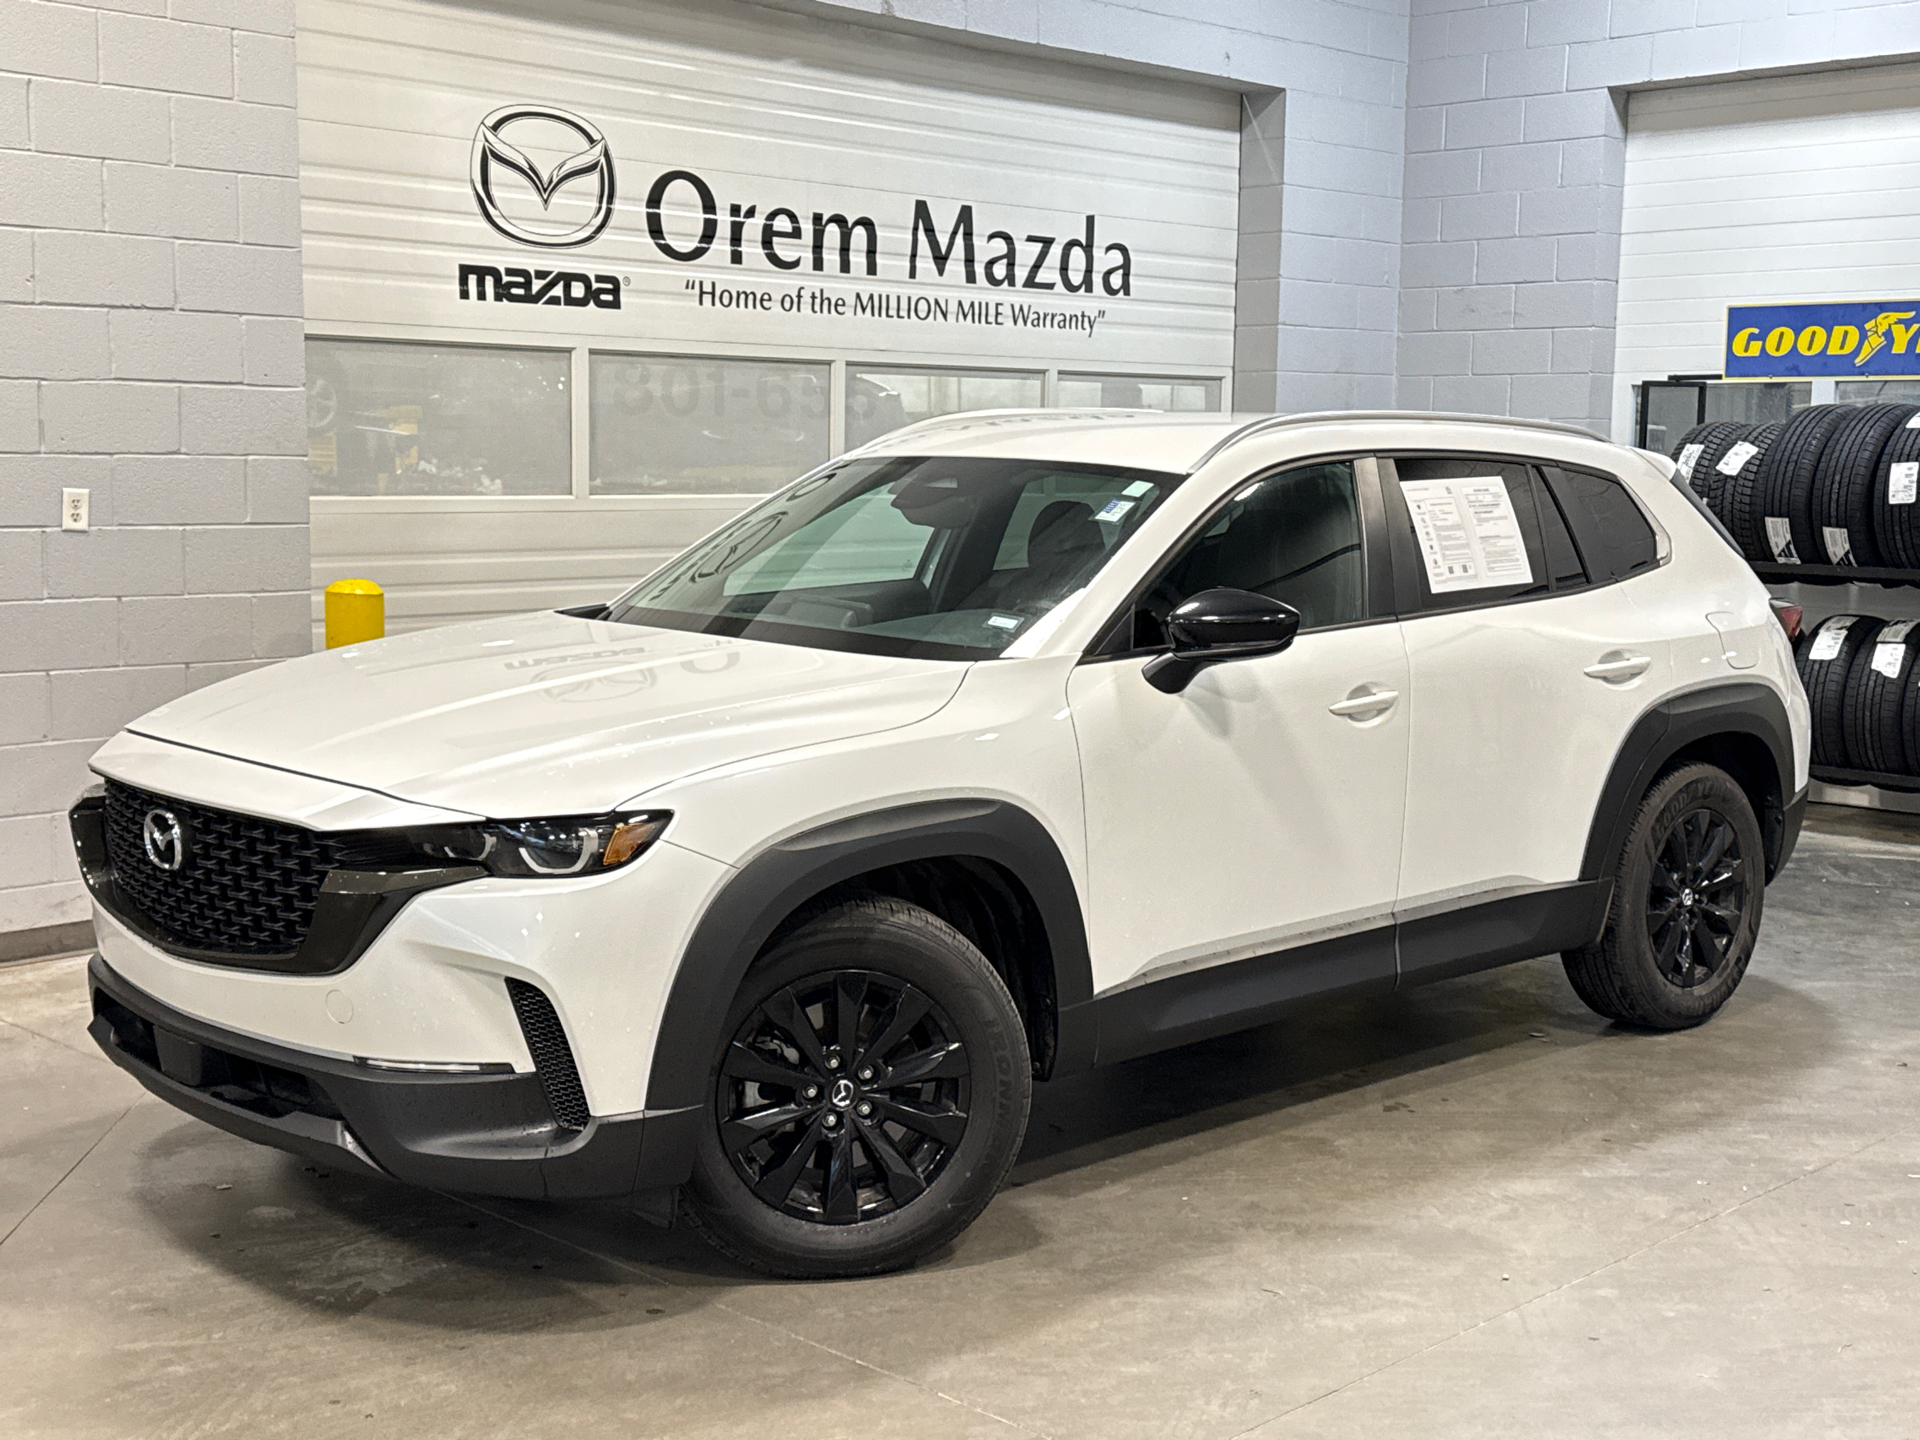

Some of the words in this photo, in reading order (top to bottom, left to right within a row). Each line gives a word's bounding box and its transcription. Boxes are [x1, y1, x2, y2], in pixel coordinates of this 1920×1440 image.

[645, 169, 877, 277] Orem
[908, 199, 1131, 297] Mazda
[458, 263, 622, 310] mazda
[780, 286, 805, 313] of
[809, 288, 846, 316] the
[853, 291, 948, 322] MILLION
[955, 299, 1004, 326] MILE
[1731, 323, 1920, 358] GOODY
